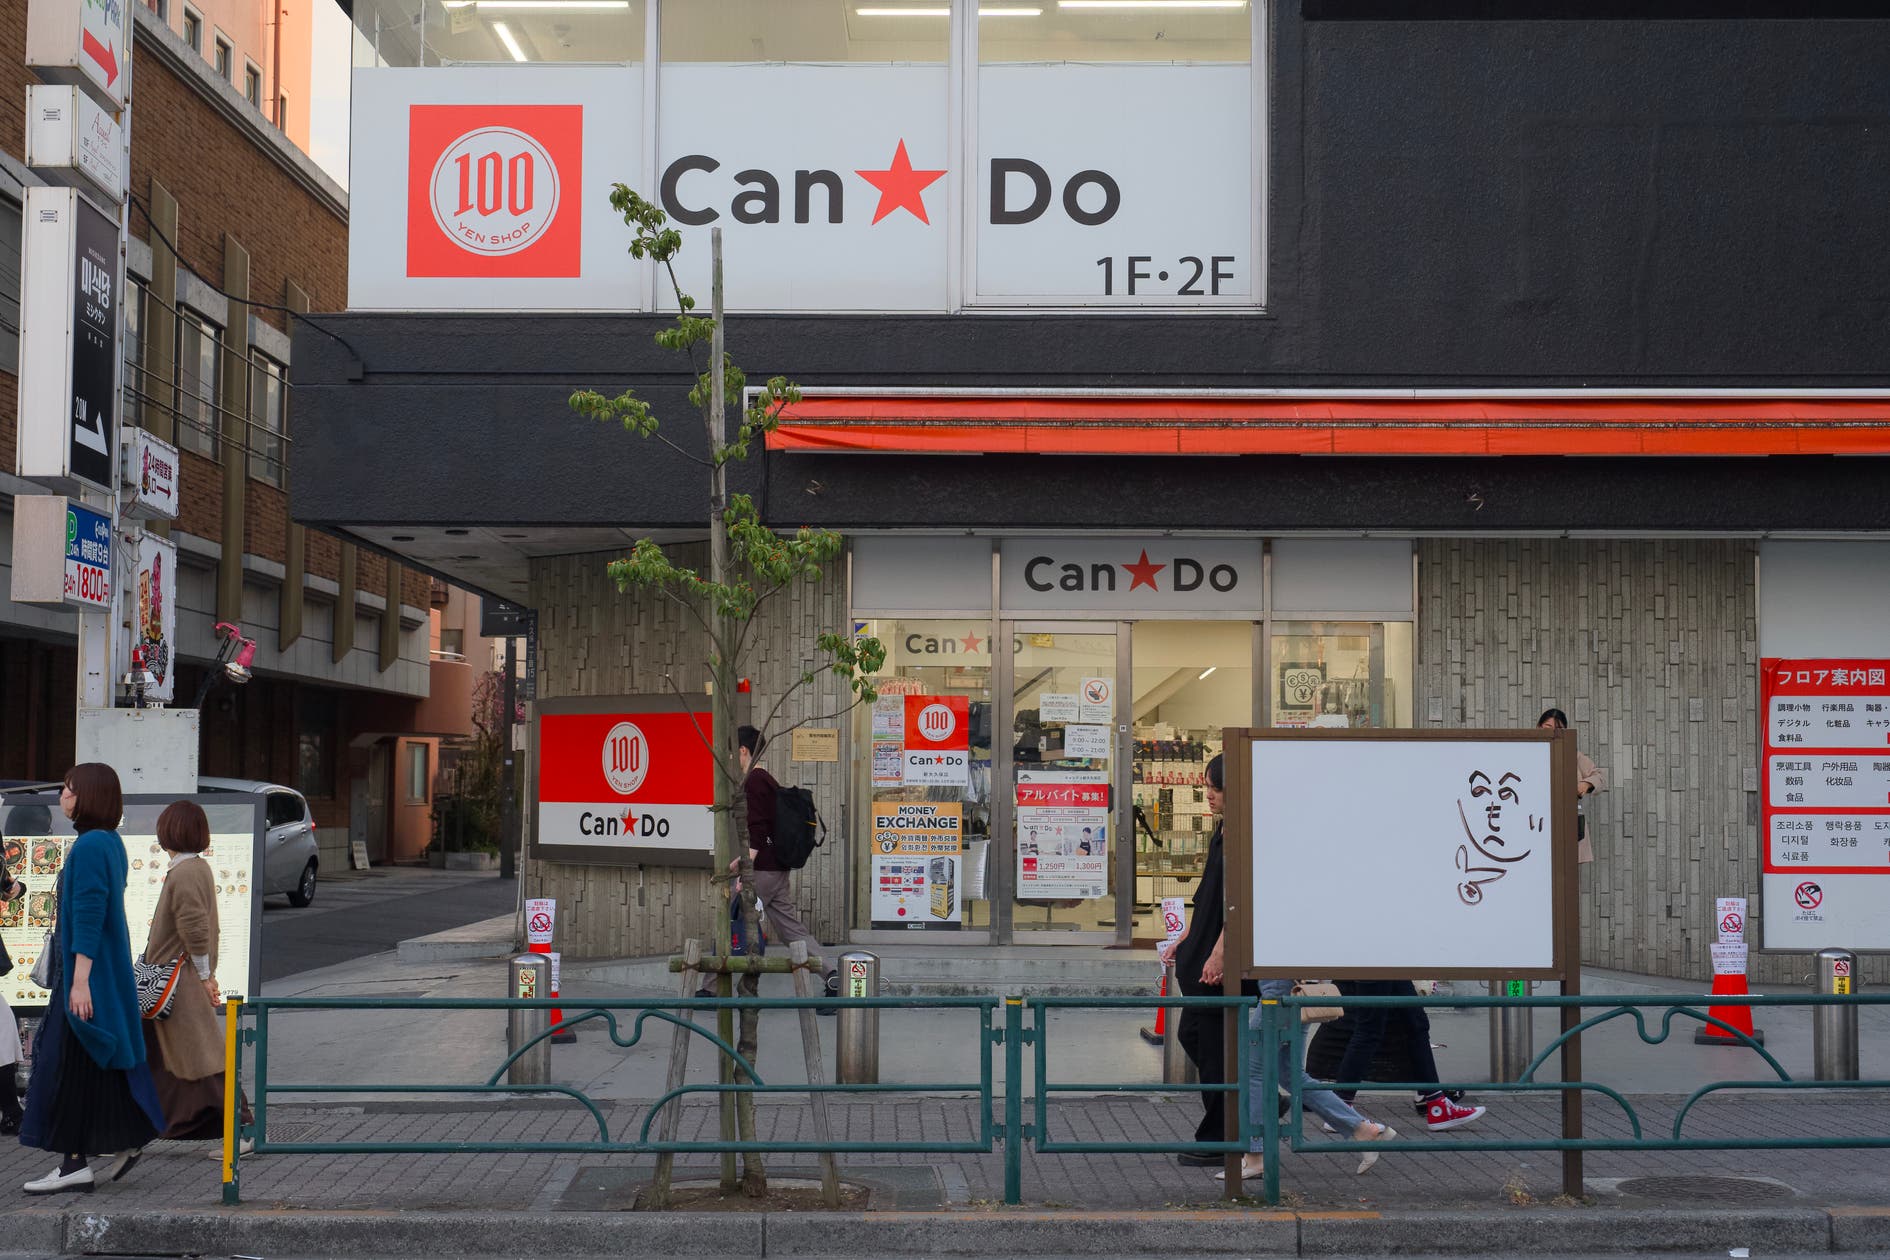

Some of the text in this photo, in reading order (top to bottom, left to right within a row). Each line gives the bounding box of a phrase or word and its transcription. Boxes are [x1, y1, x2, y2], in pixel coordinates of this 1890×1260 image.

[453, 151, 535, 218] 100
[660, 154, 1121, 226] Can Do
[456, 222, 532, 246] YEN SHOP
[1024, 556, 1239, 592] Can Do
[905, 633, 956, 654] Can
[1777, 668, 1886, 686] フロア案内図
[1777, 703, 1811, 712] 調理小物
[1822, 703, 1855, 712] 行楽用品
[925, 711, 949, 730] 100
[1777, 719, 1811, 728] デジタル
[1826, 719, 1851, 728] 化粧品
[1778, 733, 1803, 742] 食料品
[610, 736, 641, 773] 100
[909, 756, 963, 765] Can Do
[1785, 776, 1853, 786] 数码 化妆品
[1786, 793, 1804, 802] 食品
[899, 806, 936, 815] MONEY
[579, 811, 670, 838] Can Do
[876, 817, 958, 829] EXCHANGE
[1776, 821, 1814, 831] 조리소품
[1825, 821, 1862, 831] 행락용품
[1781, 835, 1858, 847] 디지털 화장품
[1781, 852, 1809, 861] 식료품
